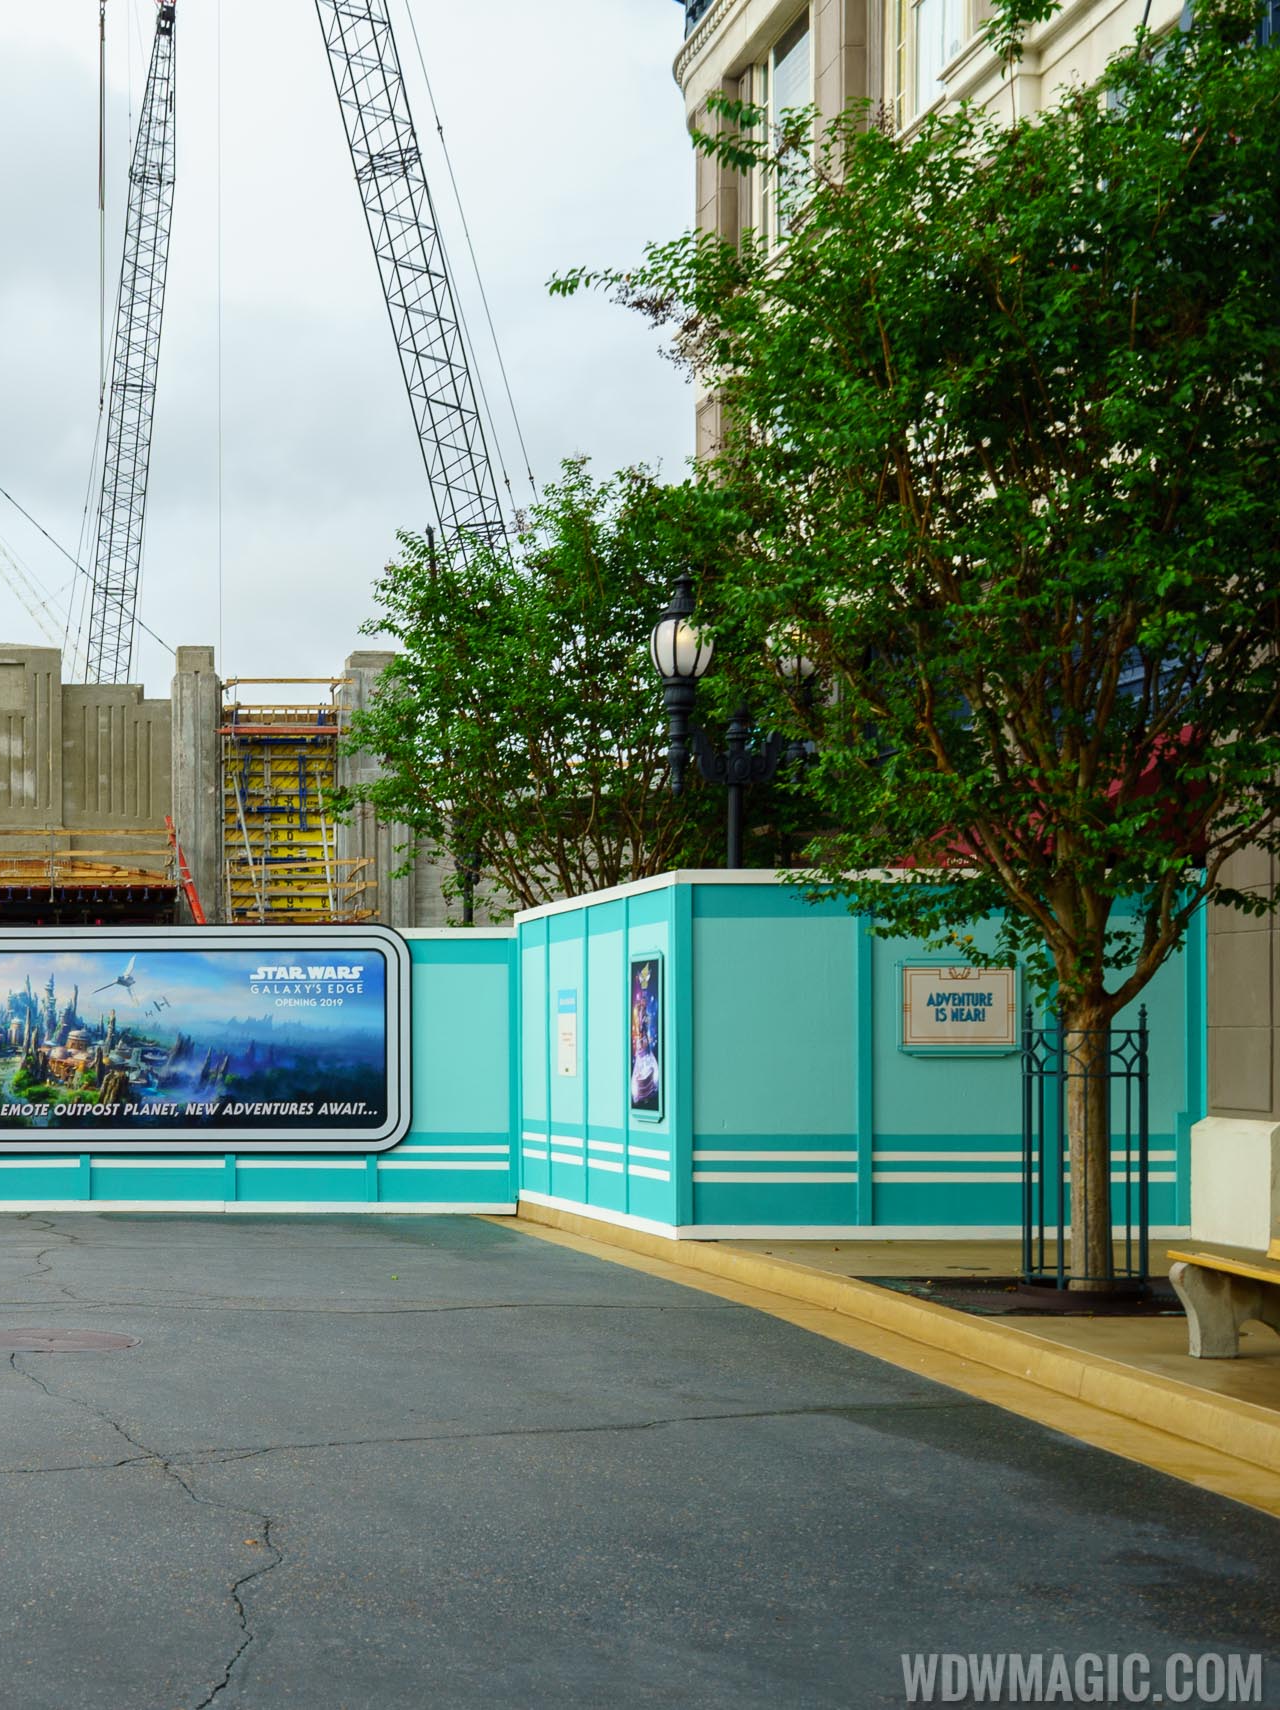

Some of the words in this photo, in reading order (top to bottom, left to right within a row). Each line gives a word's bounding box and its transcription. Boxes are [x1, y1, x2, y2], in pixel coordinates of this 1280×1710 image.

[249, 966, 307, 980] STAR
[307, 966, 364, 980] WARS
[250, 983, 322, 994] GALAXY'S
[327, 984, 364, 994] EDGE
[275, 998, 317, 1007] OPENING
[320, 998, 344, 1007] 2019
[926, 992, 993, 1006] ADVENTURE
[935, 1008, 948, 1022] IS
[950, 1008, 986, 1022] NEAR!
[53, 1103, 120, 1116] OUTPOST
[123, 1103, 180, 1118] PLANET,
[185, 1103, 220, 1116] NEW
[222, 1102, 314, 1116] ADVENTURES
[317, 1102, 379, 1115] AWAIT...
